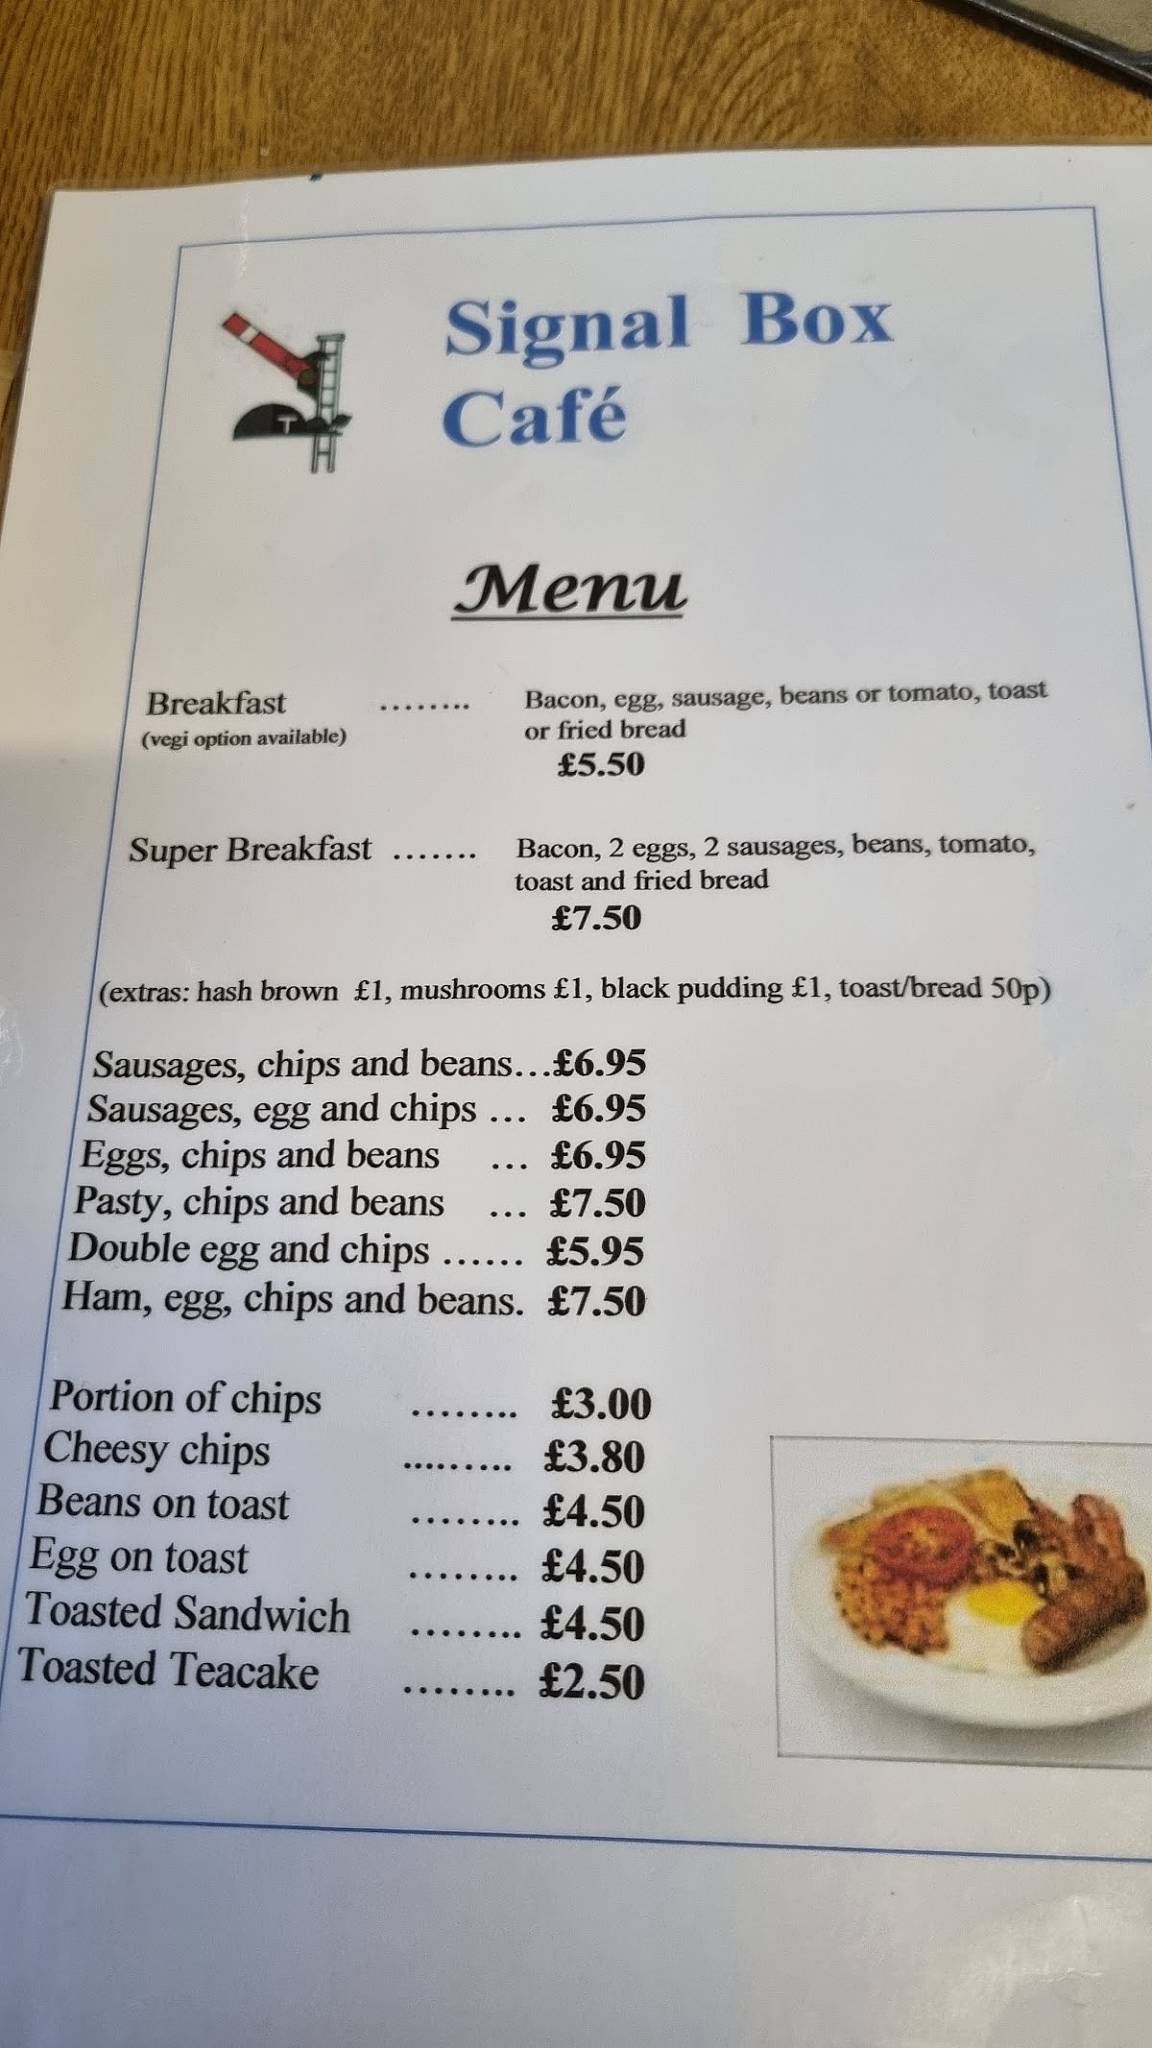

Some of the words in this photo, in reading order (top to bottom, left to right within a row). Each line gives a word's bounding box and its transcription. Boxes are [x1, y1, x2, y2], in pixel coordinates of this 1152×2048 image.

[445, 293, 691, 370] Signal
[739, 290, 895, 346] Box
[442, 384, 627, 449] Café
[452, 561, 689, 615] Menu
[145, 689, 288, 716] Breakfast
[524, 689, 607, 713] Bacon,
[613, 693, 665, 714] egg,
[671, 691, 773, 712] sausage,
[778, 683, 849, 706] beans
[855, 688, 883, 704] or
[886, 683, 983, 705] tomato,
[986, 680, 1050, 701] toast
[140, 730, 189, 752] (vegi
[193, 729, 253, 751] option
[256, 727, 348, 748] available)
[524, 725, 552, 741] or
[557, 718, 614, 741] fried
[619, 717, 688, 740] bread
[556, 750, 646, 778] £5.50
[128, 836, 220, 870] Super
[225, 833, 374, 863] Breakfast
[515, 837, 602, 863] Bacon,
[608, 836, 625, 858] 2
[631, 841, 697, 864] eggs,
[703, 835, 720, 857] 2
[726, 839, 845, 862] sausages,
[850, 831, 933, 858] beans,
[937, 834, 1037, 858] tomato,
[514, 872, 575, 892] toast
[580, 869, 627, 892] and
[633, 868, 694, 891] fried
[698, 867, 771, 891] bread
[551, 903, 642, 932] £7.50
[98, 980, 190, 1008] (extras:
[195, 978, 253, 1003] hash
[260, 978, 339, 1002] brown
[353, 979, 393, 1006] £1,
[399, 977, 547, 1001] mushrooms
[553, 976, 593, 1004] £1,
[600, 975, 671, 999] black
[676, 975, 785, 1005] pudding
[791, 975, 832, 1004] £1,
[837, 974, 984, 999] toast/bread
[990, 975, 1053, 1007] 50p)
[91, 1050, 246, 1087] Sausages,
[257, 1048, 341, 1086] chips
[350, 1047, 410, 1077] and
[86, 1093, 242, 1131] Sausages,
[253, 1101, 312, 1131] egg
[320, 1091, 380, 1123] and
[389, 1091, 477, 1131] chips
[551, 1092, 647, 1123] £6.95
[79, 1139, 170, 1177] Eggs,
[181, 1138, 267, 1178] chips
[276, 1137, 336, 1169] and
[346, 1138, 440, 1170] beans
[550, 1139, 647, 1171] £6.95
[72, 1184, 173, 1224] Pasty,
[183, 1184, 270, 1225] chips
[278, 1184, 340, 1216] and
[349, 1184, 445, 1217] beans
[549, 1187, 647, 1219] £7.50
[67, 1231, 191, 1264] Double
[199, 1241, 261, 1272] egg
[268, 1231, 331, 1264] and
[340, 1232, 430, 1274] chips
[545, 1235, 645, 1267] £5.95
[60, 1279, 153, 1319] Ham,
[164, 1289, 233, 1321] egg,
[243, 1280, 334, 1322] chips
[344, 1281, 407, 1315] and
[416, 1281, 524, 1317] beans.
[546, 1284, 649, 1318] £7.50
[48, 1378, 175, 1413] Portion
[185, 1379, 228, 1414] of
[230, 1379, 322, 1424] chips
[550, 1386, 653, 1421] £3.00
[43, 1428, 171, 1474] Cheesy
[179, 1431, 271, 1476] chips
[543, 1438, 646, 1474] £3.80
[35, 1482, 141, 1519] Beans
[152, 1494, 197, 1519] on
[206, 1489, 291, 1521] toast
[542, 1492, 646, 1530] £4.50
[28, 1535, 101, 1581] Egg
[110, 1546, 153, 1573] on
[164, 1541, 250, 1575] toast
[540, 1547, 646, 1585] £4.50
[24, 1590, 163, 1629] Toasted
[174, 1594, 352, 1634] Sandwich
[539, 1603, 646, 1643] £4.50
[17, 1646, 157, 1687] Toasted
[169, 1650, 320, 1691] Teacake
[538, 1661, 646, 1701] £2.50
